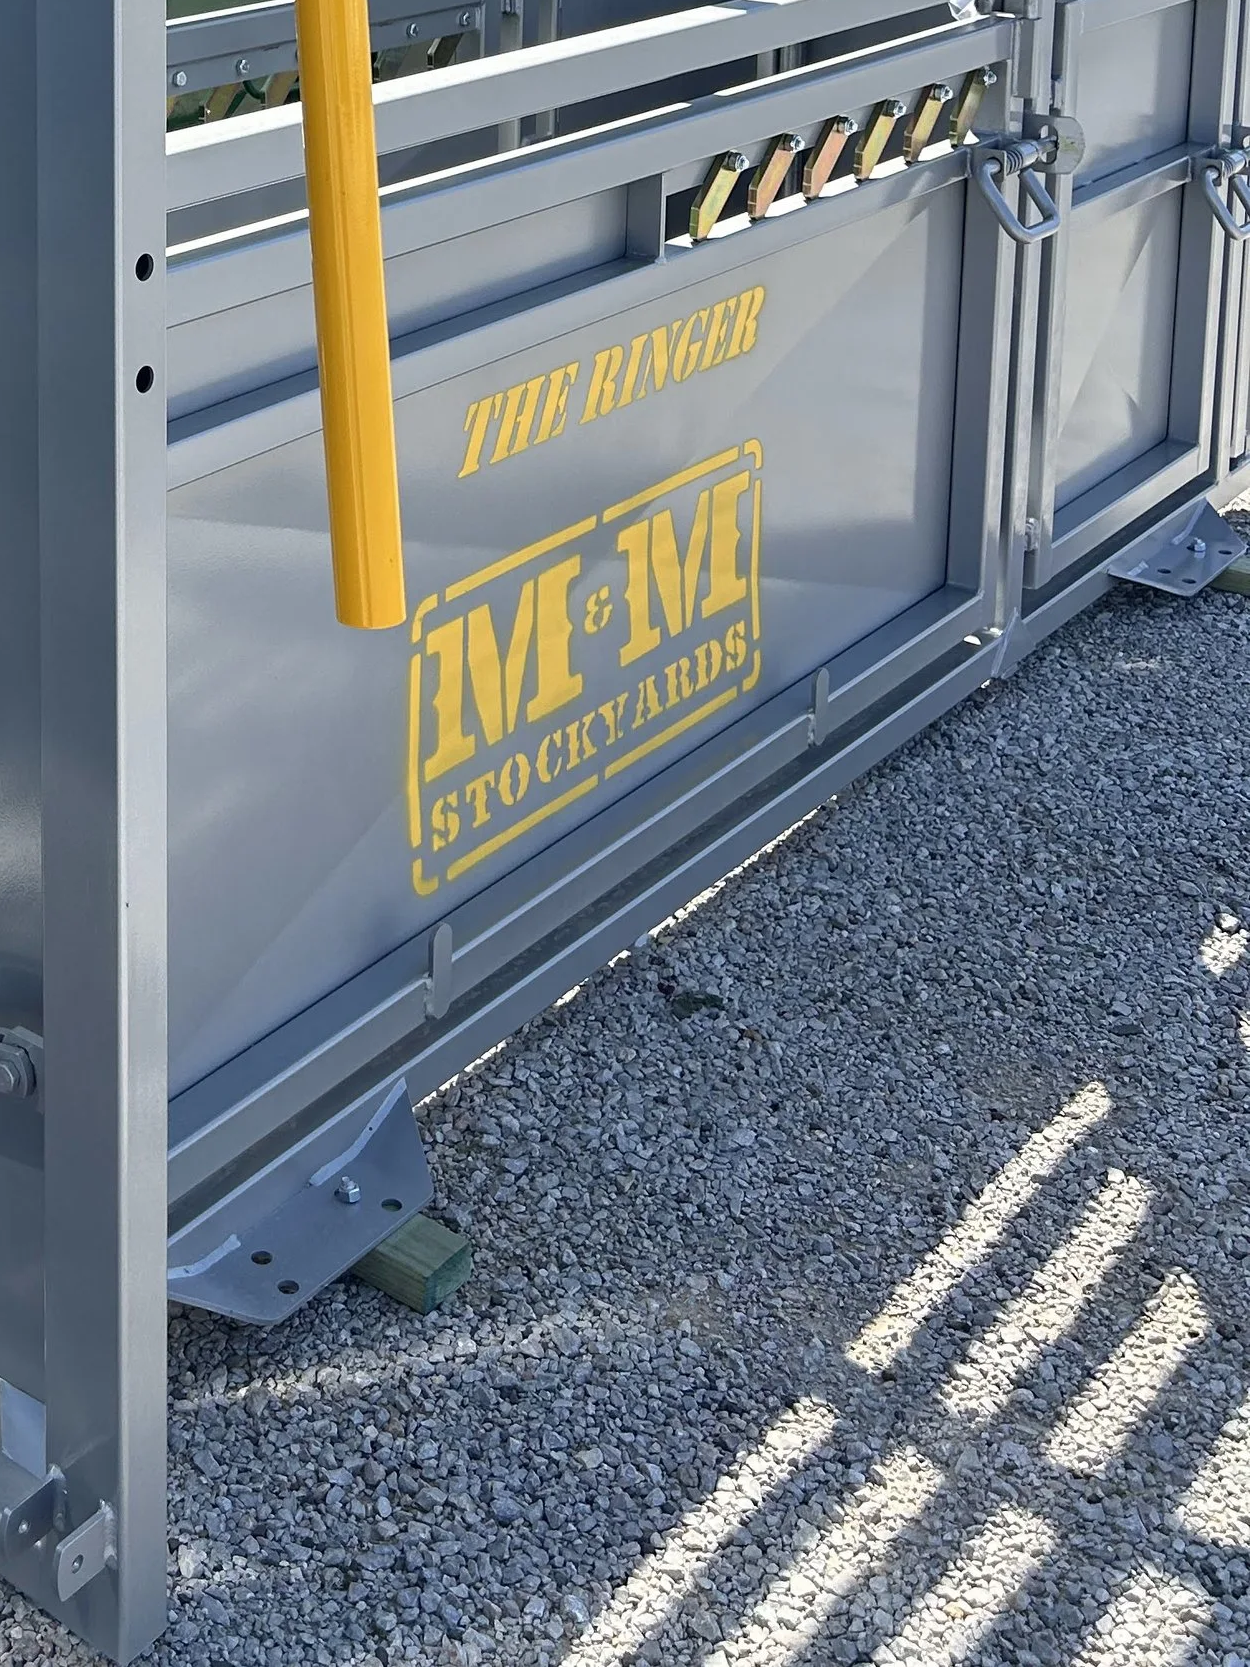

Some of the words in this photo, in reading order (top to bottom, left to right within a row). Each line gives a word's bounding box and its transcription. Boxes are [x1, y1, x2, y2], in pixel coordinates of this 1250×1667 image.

[457, 362, 579, 479] THE
[579, 286, 767, 426] RINGER
[431, 619, 747, 851] STOCKYARDS
